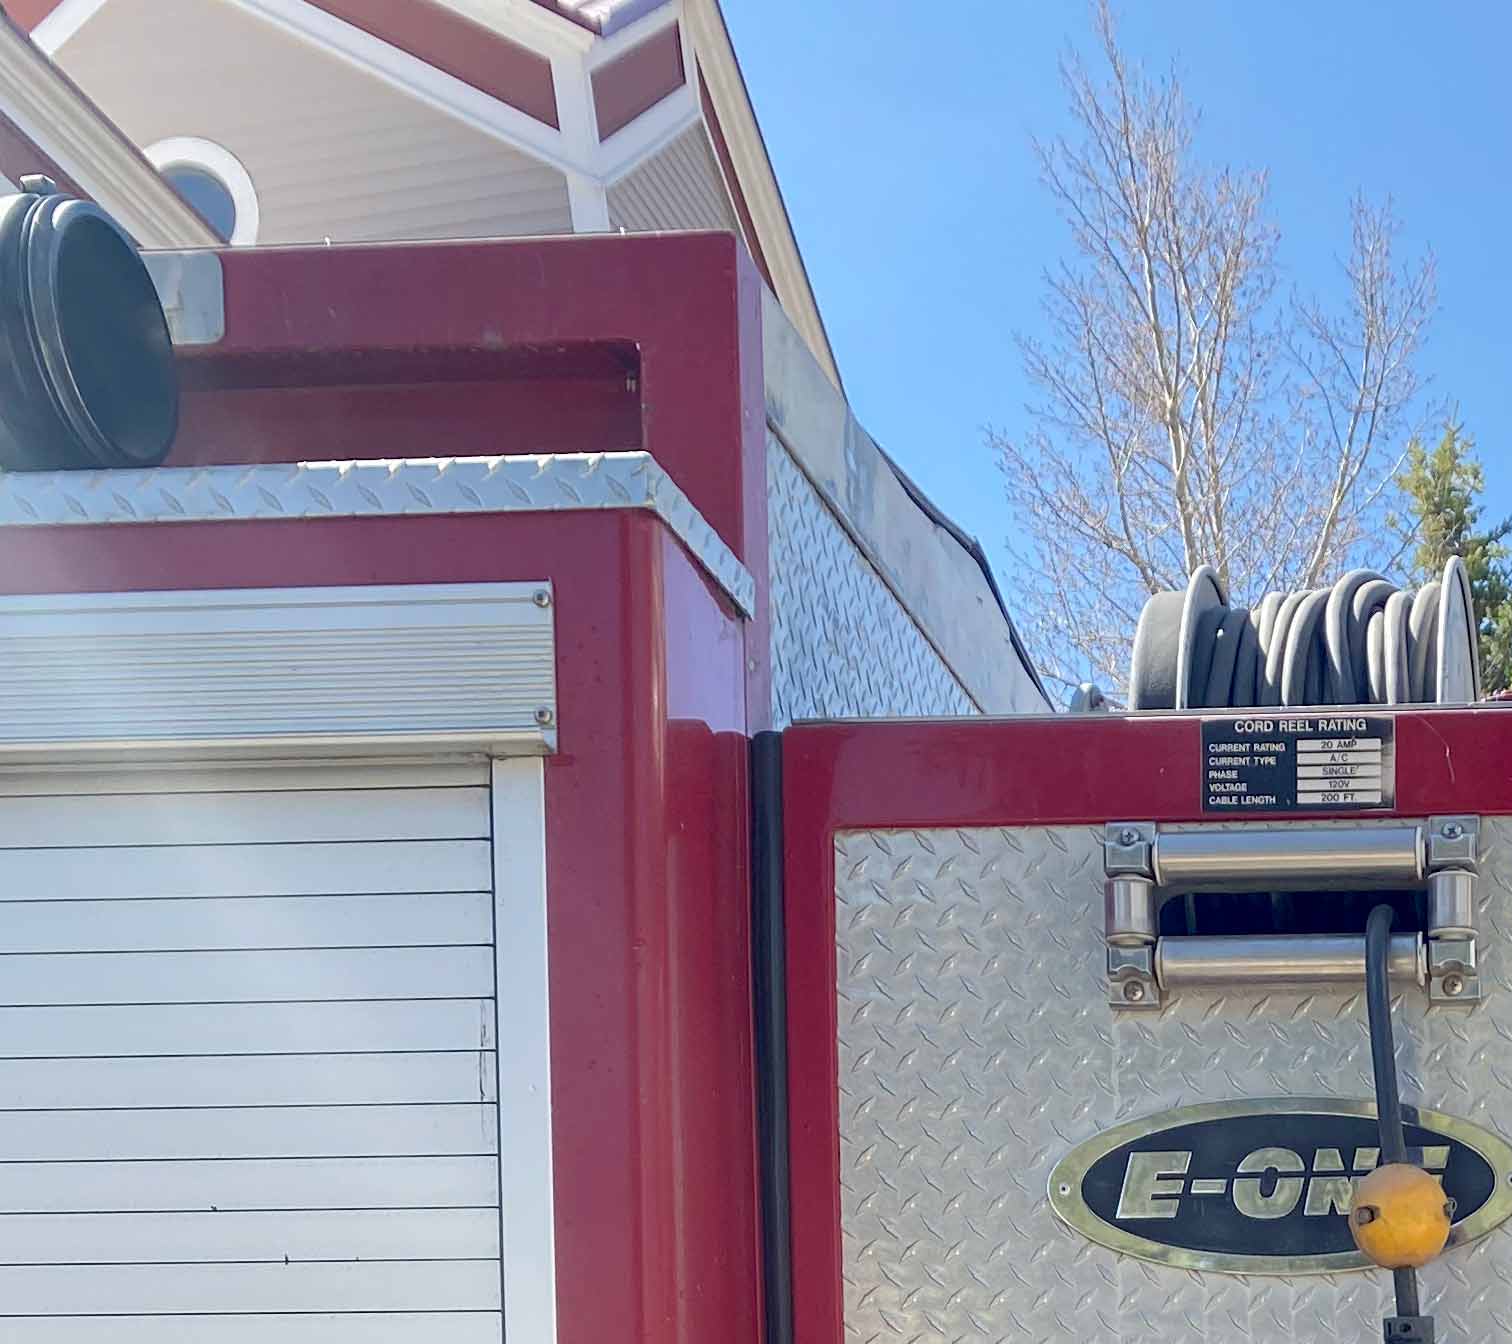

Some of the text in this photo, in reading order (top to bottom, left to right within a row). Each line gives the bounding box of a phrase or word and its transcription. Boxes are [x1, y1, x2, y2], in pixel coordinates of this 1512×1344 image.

[1234, 719, 1367, 732] CORD REEL RATING
[1208, 743, 1286, 752] CURRENT RATING
[1321, 740, 1357, 749] 20 AMP
[1208, 757, 1277, 766] CURRENT TYPE
[1330, 754, 1349, 762] A/C
[1208, 770, 1238, 779] PHASE
[1322, 766, 1356, 775] SINGLE
[1208, 783, 1247, 792] VOLTAGE
[1328, 780, 1350, 788] 120V
[1208, 796, 1276, 805] CABLE LENGTH
[1321, 793, 1339, 802] 200
[1115, 1146, 1450, 1219] E-ON
